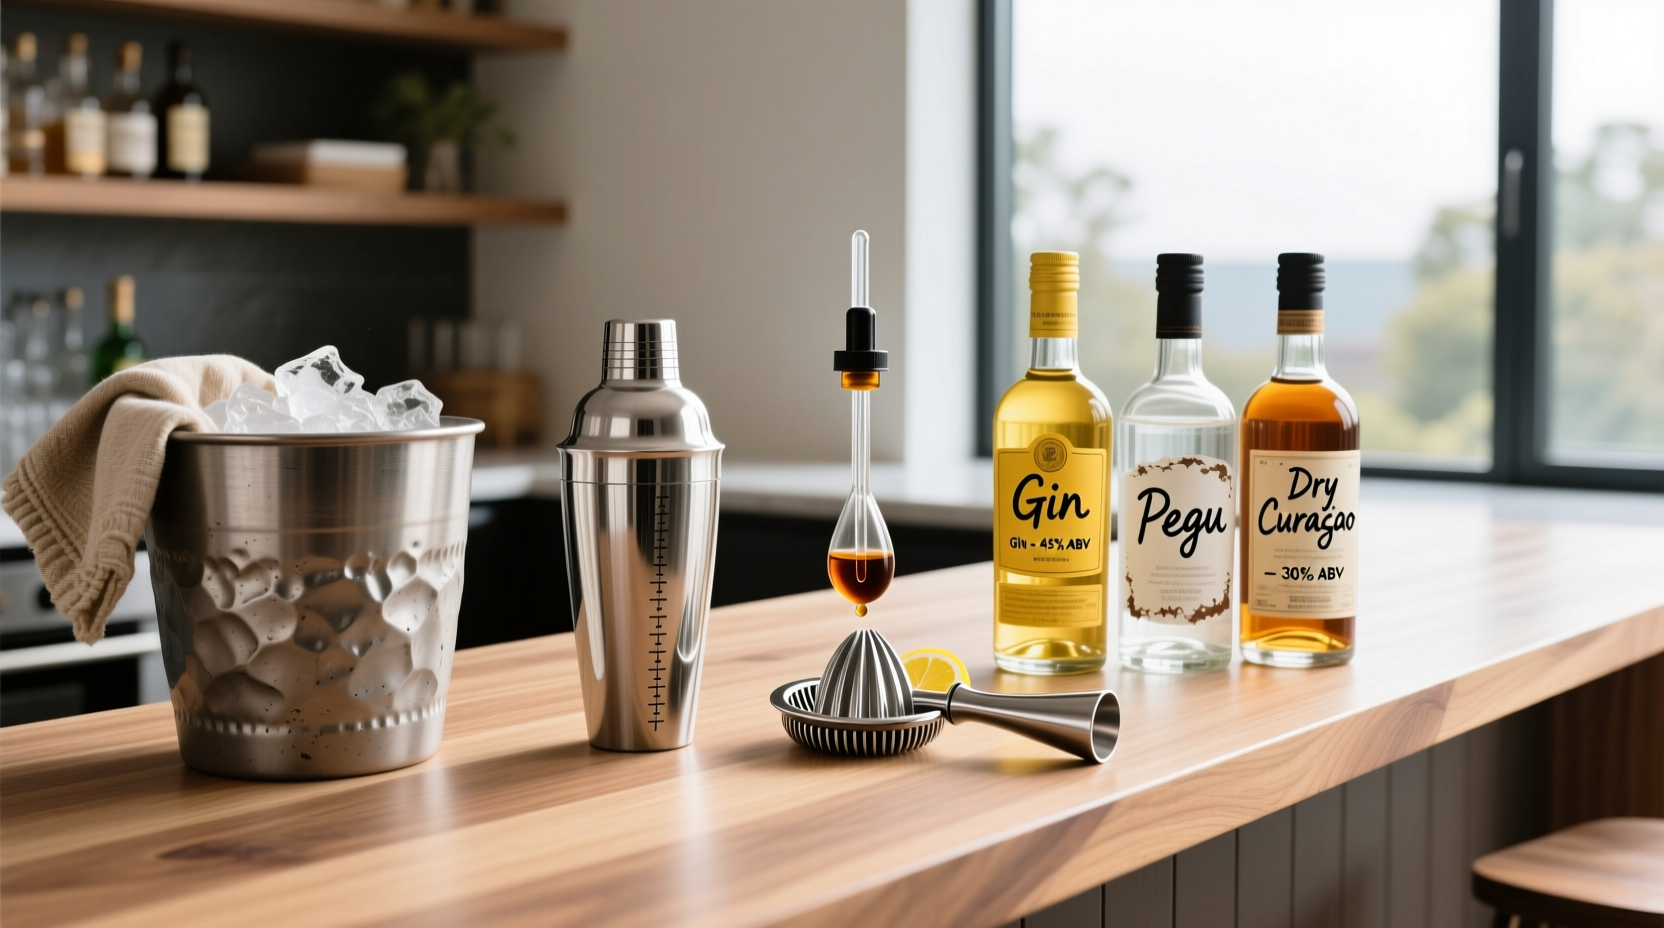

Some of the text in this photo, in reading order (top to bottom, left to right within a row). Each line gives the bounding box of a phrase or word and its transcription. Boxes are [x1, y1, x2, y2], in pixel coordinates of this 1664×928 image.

[1012, 473, 1091, 530] Gin
[1287, 466, 1339, 512] Dry
[1065, 537, 1091, 550] ABV
[1137, 486, 1228, 559] Pegu
[1281, 566, 1314, 582] 30%
[1317, 566, 1345, 581] ABV
